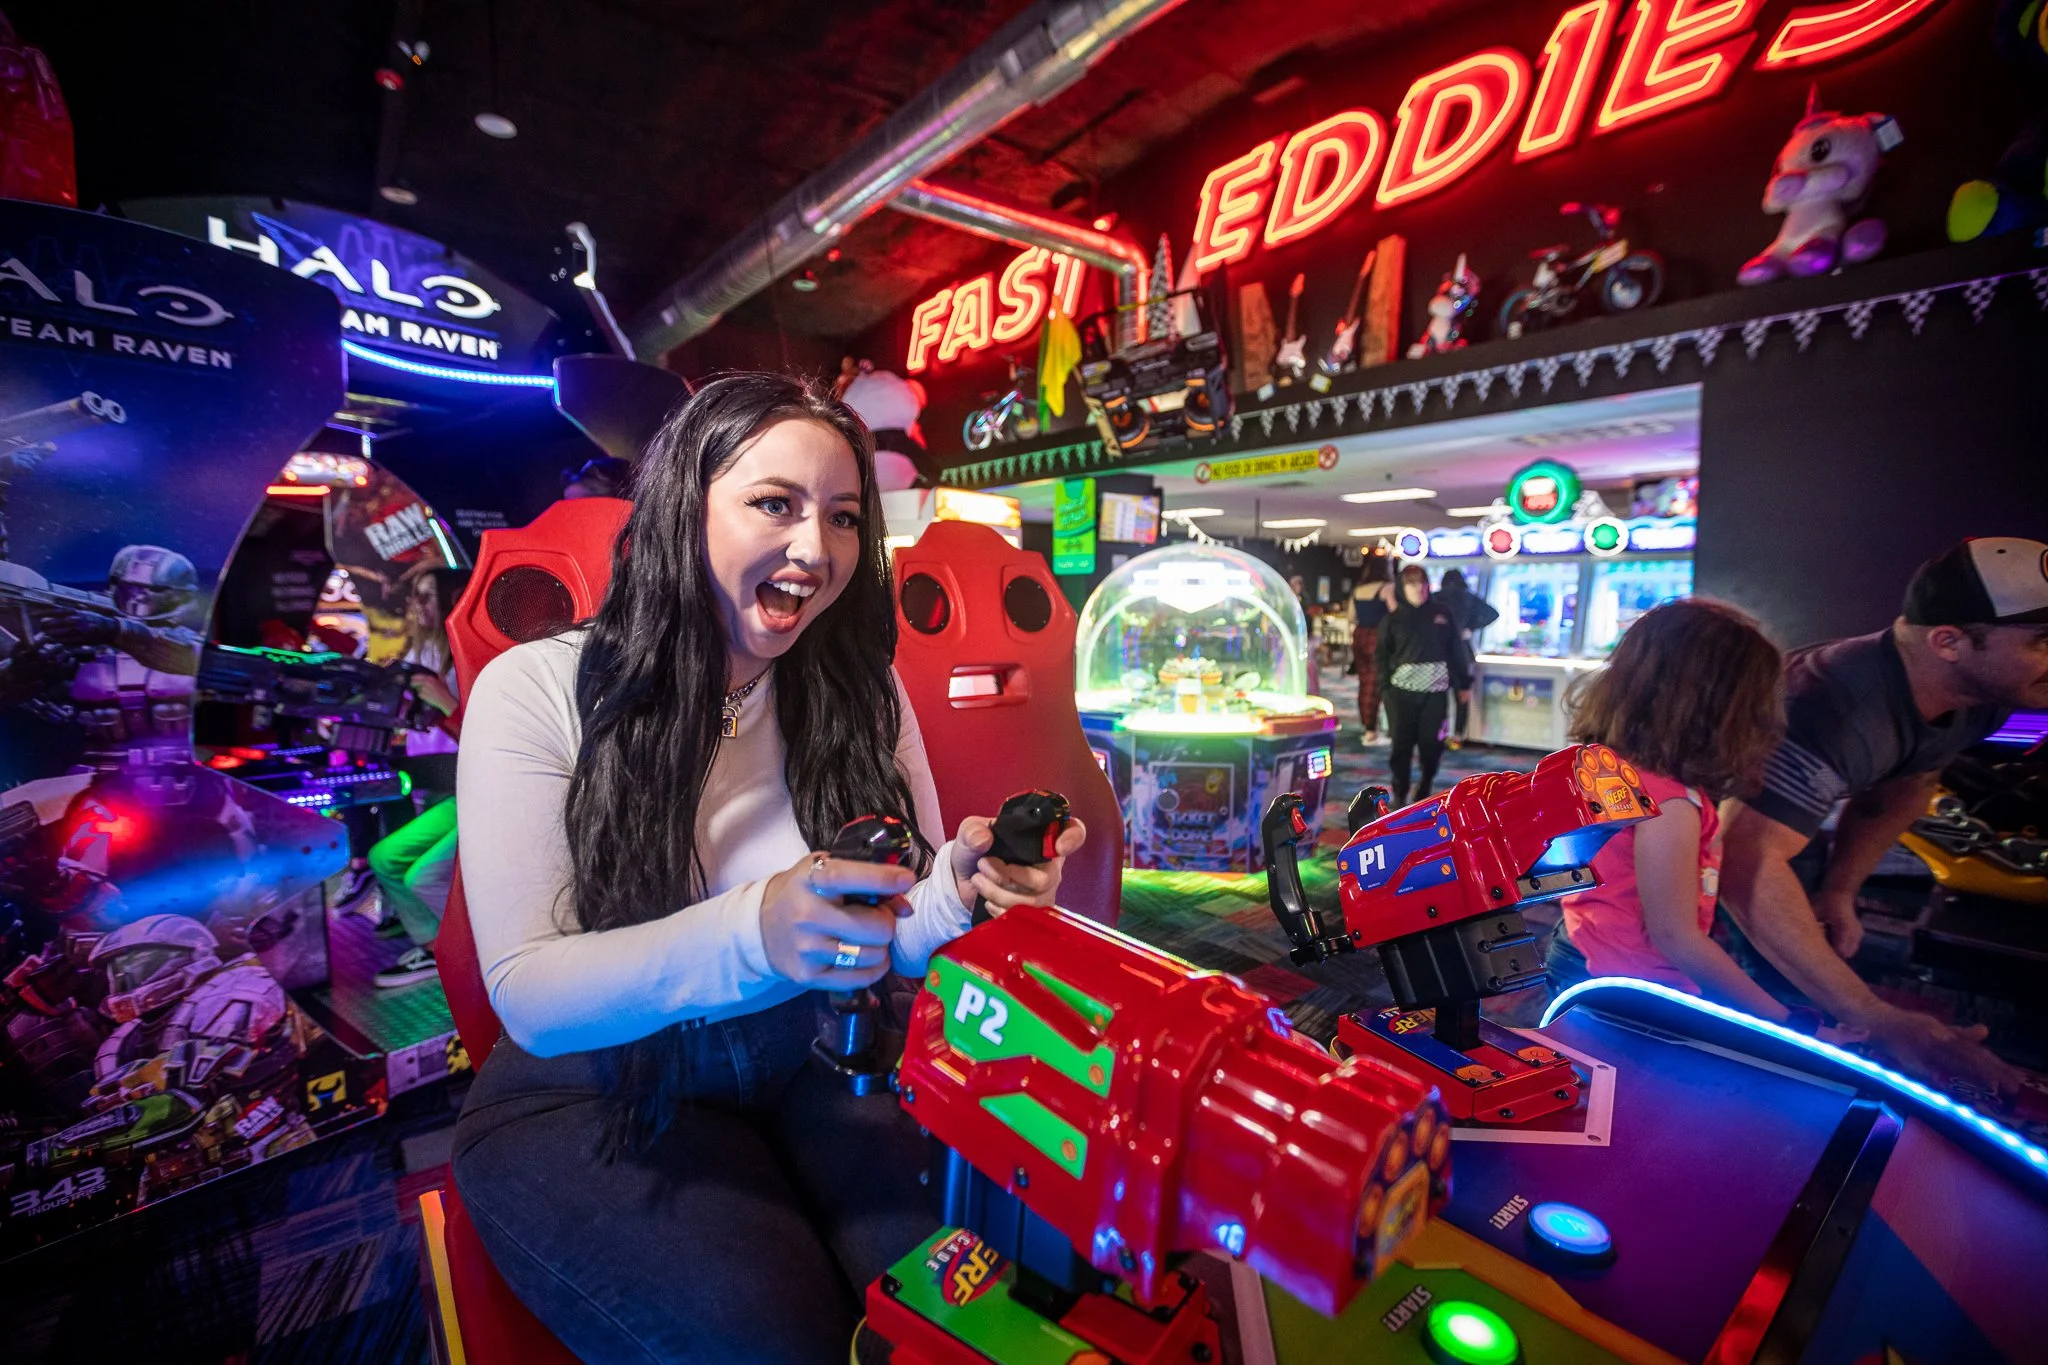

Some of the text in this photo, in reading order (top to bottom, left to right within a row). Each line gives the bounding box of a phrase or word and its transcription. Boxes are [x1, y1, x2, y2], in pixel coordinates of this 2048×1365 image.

[0, 257, 235, 327] ALO
[207, 216, 501, 319] HALO
[340, 308, 499, 361] AM RAVEN
[906, 245, 1085, 374] FAST
[0, 315, 233, 370] EAM RAVEN
[364, 502, 425, 547] RAW
[1605, 787, 1627, 805] NERF
[1358, 843, 1386, 876] P1
[953, 980, 1009, 1047] P2
[10, 1166, 106, 1217] 343
[1488, 1194, 1530, 1231] START!
[926, 1232, 971, 1272] CADE
[953, 1240, 1000, 1308] ERF
[1381, 1285, 1433, 1333] START!
